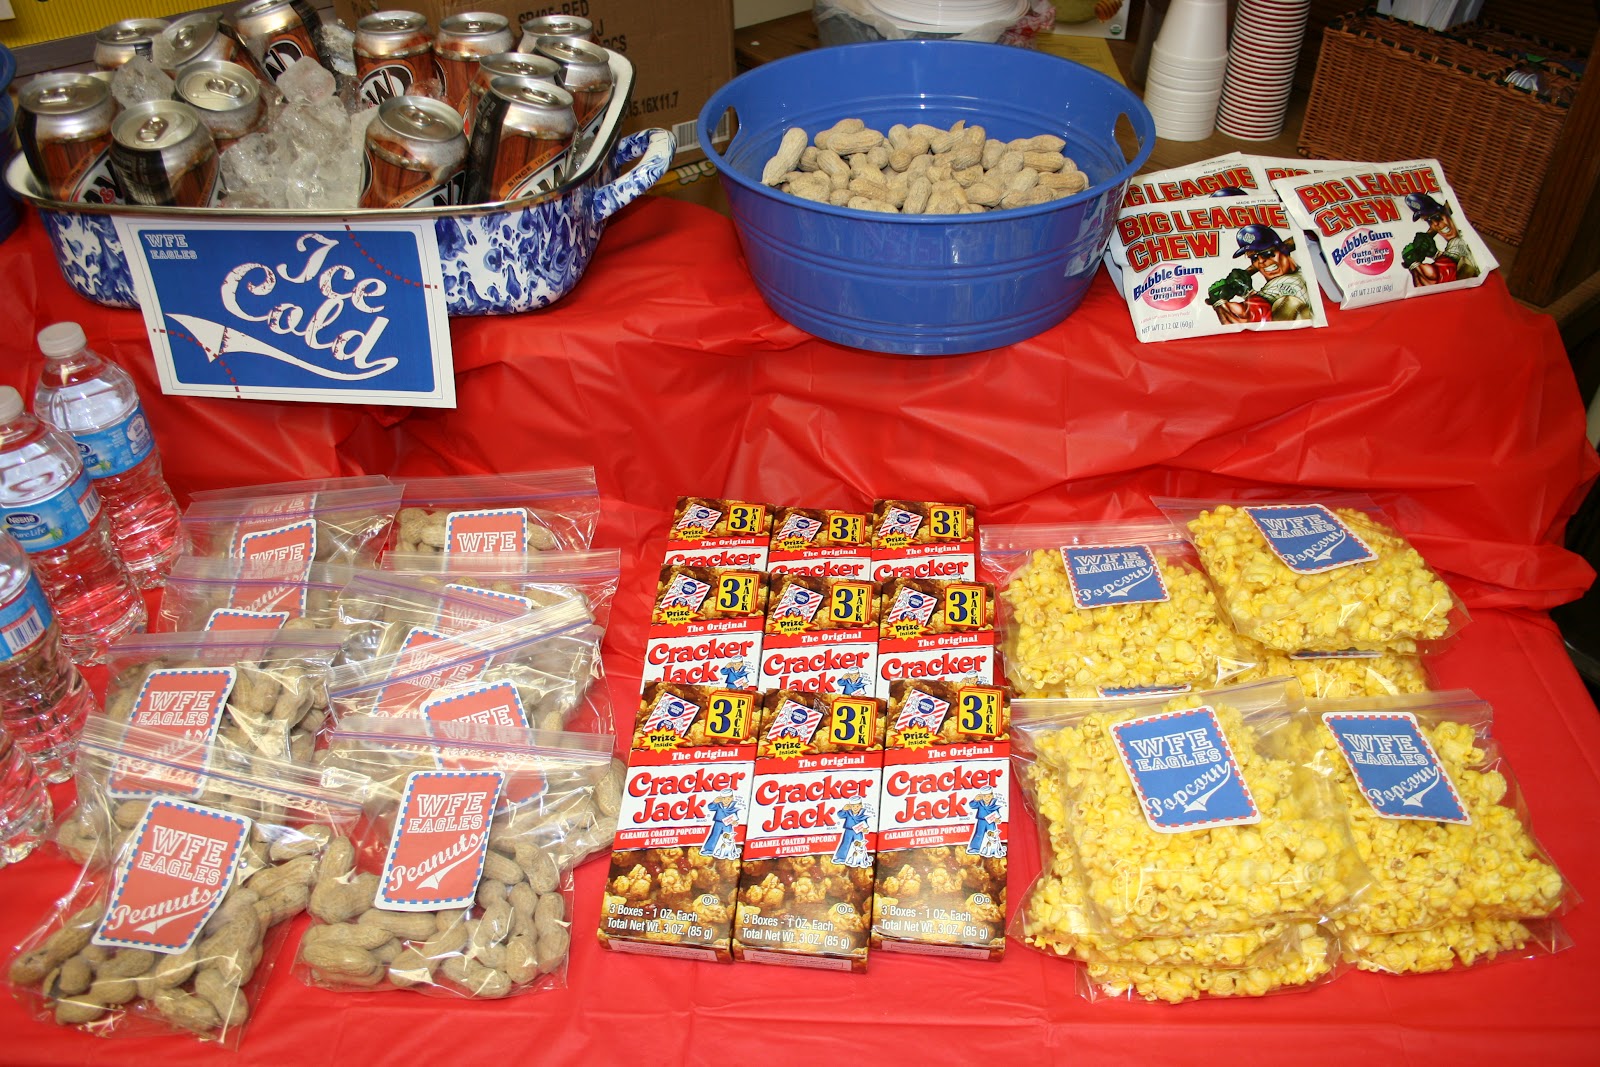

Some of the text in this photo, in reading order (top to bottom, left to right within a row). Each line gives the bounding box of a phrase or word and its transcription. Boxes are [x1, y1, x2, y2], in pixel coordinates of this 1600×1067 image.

[1143, 167, 1258, 203] LEAGUE
[1294, 179, 1353, 214] BIG
[1342, 166, 1442, 199] LEAGUE
[1116, 203, 1290, 247] BIG LEAGUE
[1314, 197, 1401, 237] CHEW
[144, 234, 188, 247] WFE
[1331, 230, 1393, 266] Bubble Gum
[150, 249, 198, 259] EAGLES
[1126, 231, 1220, 273] CHEW
[275, 232, 387, 313] Ice
[1133, 265, 1203, 301] Bubble Gum
[1150, 286, 1172, 295] Outta
[1153, 290, 1186, 301] Original
[220, 262, 399, 369] Cold
[730, 507, 759, 532] 3 PACK
[831, 517, 859, 542] 3 PACK
[933, 510, 951, 535] 3
[1259, 514, 1327, 531] WFE
[1267, 523, 1336, 538] EAGLES
[30, 527, 46, 536] Life
[456, 531, 517, 552] WFE
[718, 538, 755, 547] Original
[924, 545, 960, 554] Original
[1282, 530, 1346, 565] Popcorn
[873, 559, 969, 581] Cracker
[1074, 551, 1141, 567] WFE
[1076, 558, 1147, 575] EAGLES
[719, 578, 752, 611] 3 PACK
[1078, 566, 1153, 601] Popcorn
[666, 610, 690, 618] Prize
[834, 588, 865, 622] 3 PACK
[949, 591, 979, 625] 3 PACK
[687, 621, 747, 633] The Original
[780, 619, 805, 628] Prize
[895, 623, 920, 632] Prize
[801, 631, 862, 643] The Original
[917, 635, 978, 647] The Original
[648, 638, 755, 665] Cracker
[763, 648, 870, 676] Cracker
[654, 660, 720, 685] Jack
[881, 652, 988, 681] Cracker
[149, 690, 216, 711] WFE
[137, 712, 209, 726] EAGLES
[709, 698, 745, 738] 3 PACK
[834, 706, 868, 744] 3 PACK
[961, 694, 995, 734] 3 PACK
[650, 735, 676, 743] Prize
[774, 741, 801, 751] Prize
[903, 732, 930, 741] Prize
[1129, 728, 1213, 758] WFE
[1342, 733, 1419, 754] WFE
[671, 748, 738, 761] The Original
[798, 756, 865, 769] The Original
[927, 745, 994, 759] The Original
[1135, 748, 1222, 772] EAGLES
[1351, 751, 1429, 766] EAGLES
[628, 768, 746, 798] Cracker
[755, 775, 874, 806] Cracker
[887, 765, 1003, 797] Cracker
[1145, 761, 1231, 818] Popcorn
[1367, 765, 1440, 807] Popcorn
[417, 791, 487, 818] WFE
[633, 794, 707, 824] Jack
[894, 792, 968, 823] Jack
[407, 815, 483, 833] EAGLES
[762, 802, 836, 833] Jack
[620, 827, 706, 840] CARAMEL COATED POPCORN
[651, 837, 679, 845] PEANUTS
[750, 834, 837, 849] CARAMEL COATED POPCORN
[884, 825, 970, 841] CARAMEL COATED POPCORN
[916, 836, 944, 845] PEANUTS
[153, 825, 228, 868] WFE
[781, 845, 810, 853] PEANUTS
[138, 851, 221, 886] EAGLES
[389, 831, 486, 891] Peanuts
[108, 886, 221, 931] Peanuts
[617, 904, 698, 922] Boxes OZ. Each
[890, 905, 972, 922] Boxes OZ. Each
[607, 917, 713, 940] Total Net Wt. OZ. (85 g)
[752, 914, 834, 932] Boxes OZ. Each
[881, 919, 988, 940] Total Net Wt. OZ. (85 g)
[742, 928, 850, 949] Total Net Wt. OZ. (85 g)
